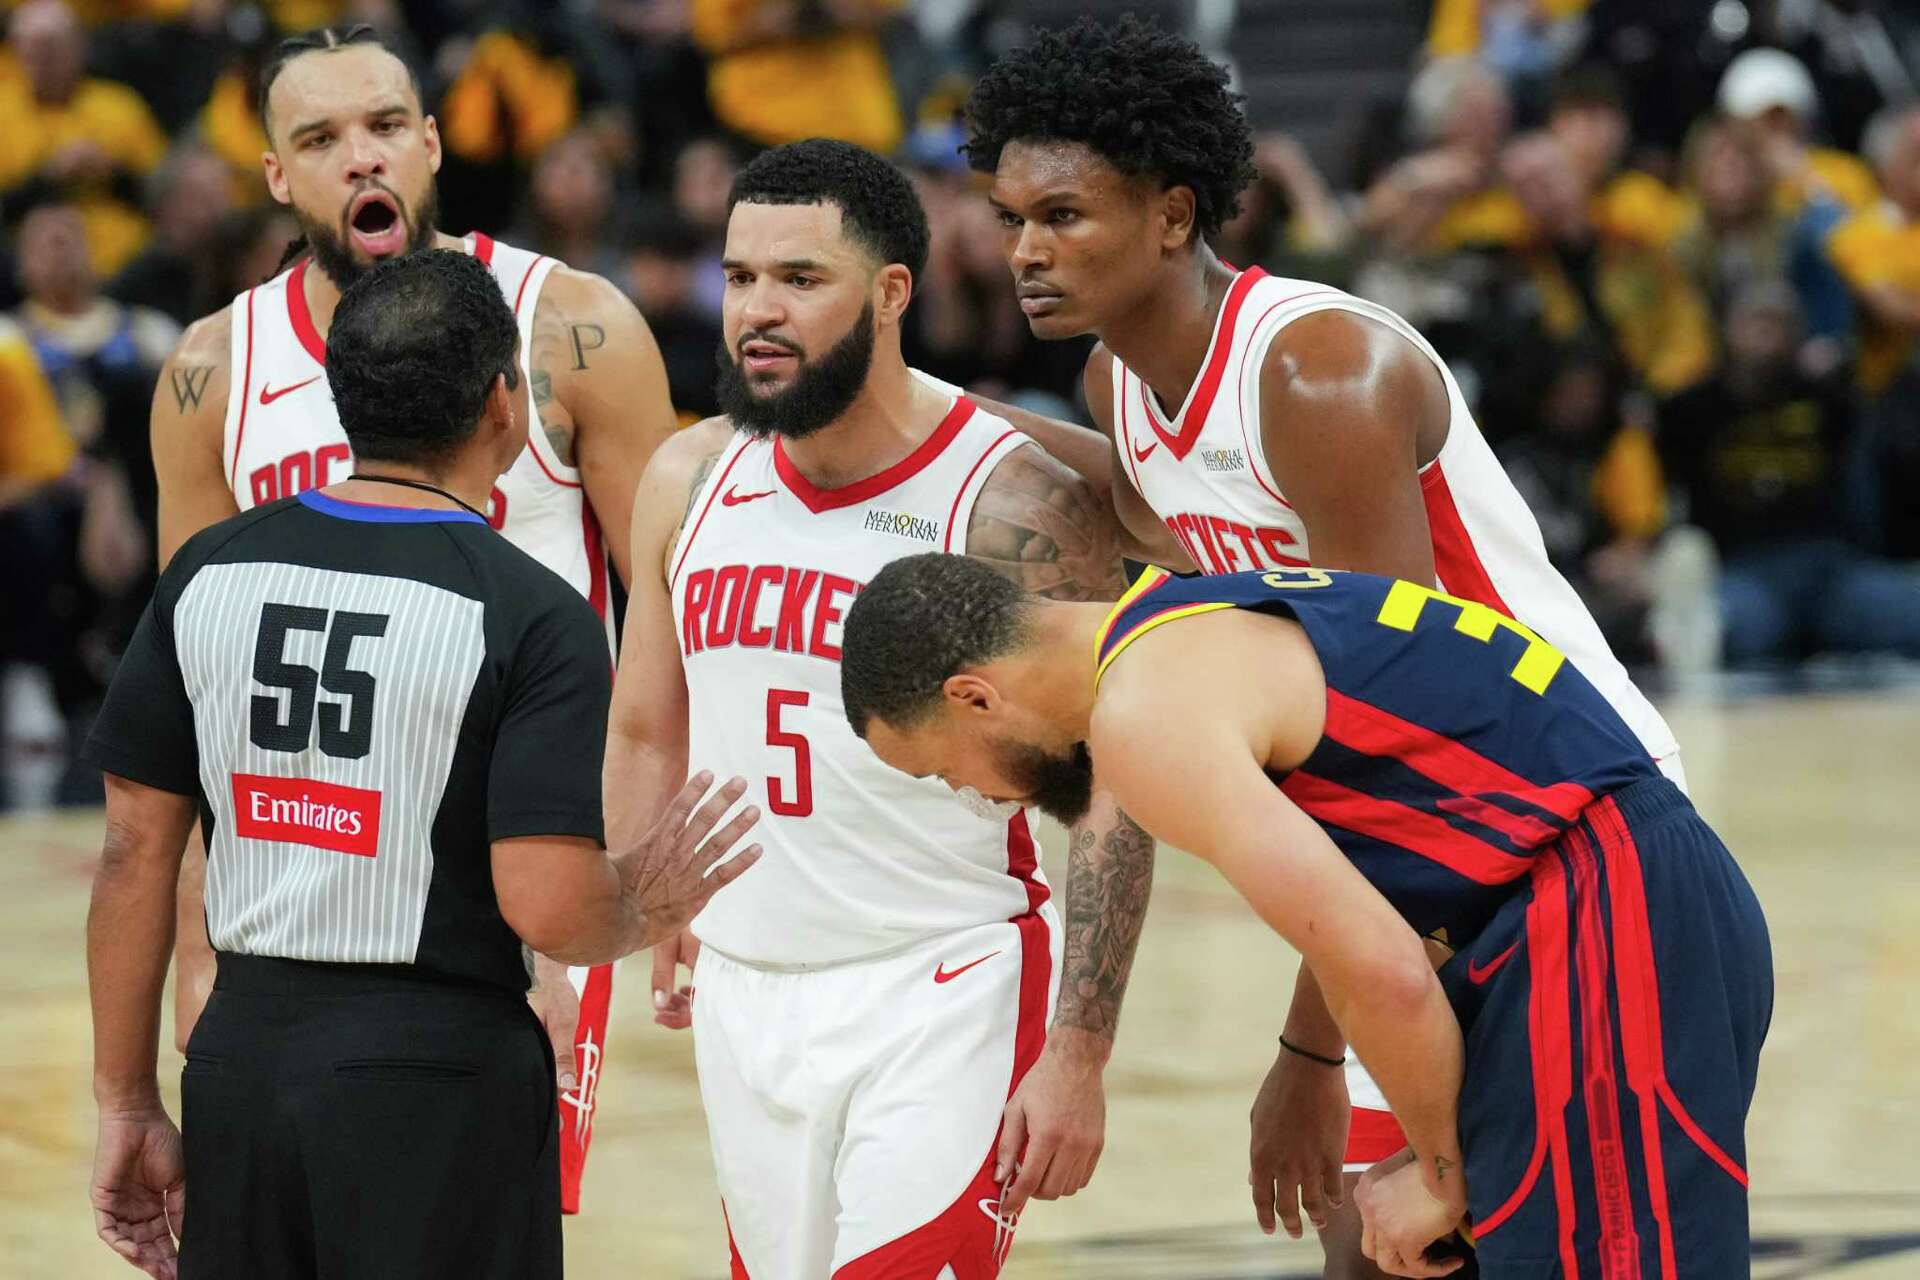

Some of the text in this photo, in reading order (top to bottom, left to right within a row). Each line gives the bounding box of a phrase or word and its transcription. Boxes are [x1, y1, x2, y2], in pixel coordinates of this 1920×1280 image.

[864, 519, 938, 542] HERMANN
[866, 509, 938, 532] MEMORIAL
[683, 564, 864, 663] ROCKE
[250, 602, 390, 760] 55
[766, 688, 813, 818] 5
[249, 791, 361, 836] Emirates
